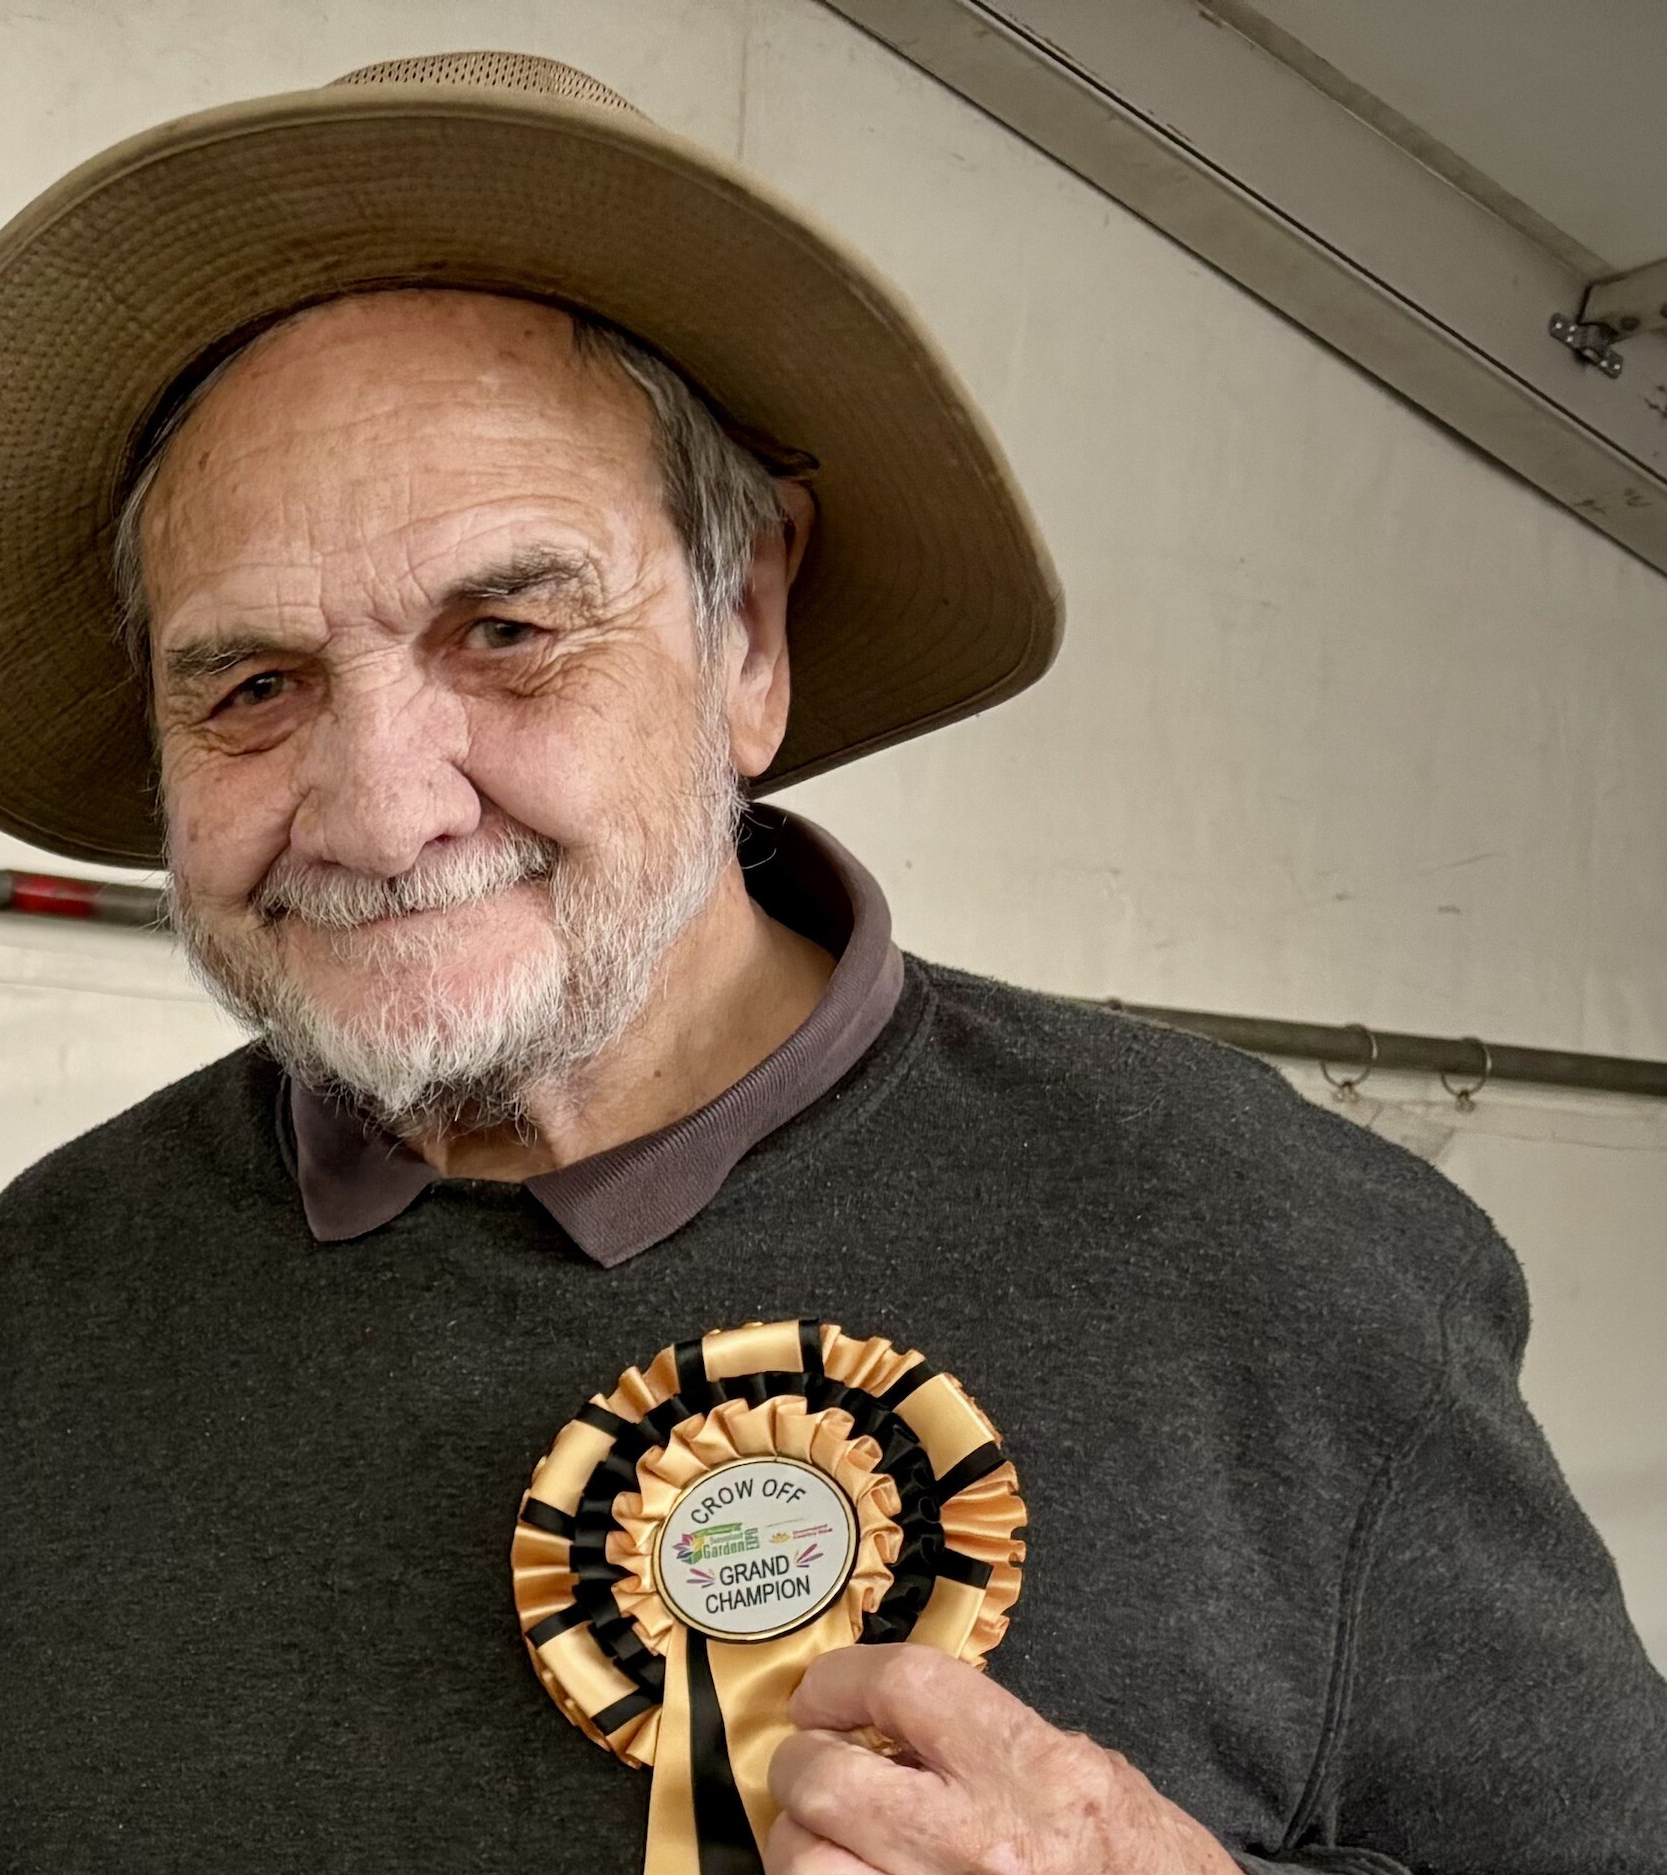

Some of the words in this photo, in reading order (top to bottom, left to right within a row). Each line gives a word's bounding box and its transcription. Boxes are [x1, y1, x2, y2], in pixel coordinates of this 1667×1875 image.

[691, 1478, 754, 1524] CROW
[761, 1478, 806, 1504] OFF
[703, 1541, 745, 1559] Garden
[719, 1554, 789, 1586] GRAND
[705, 1575, 810, 1614] CHAMPION
